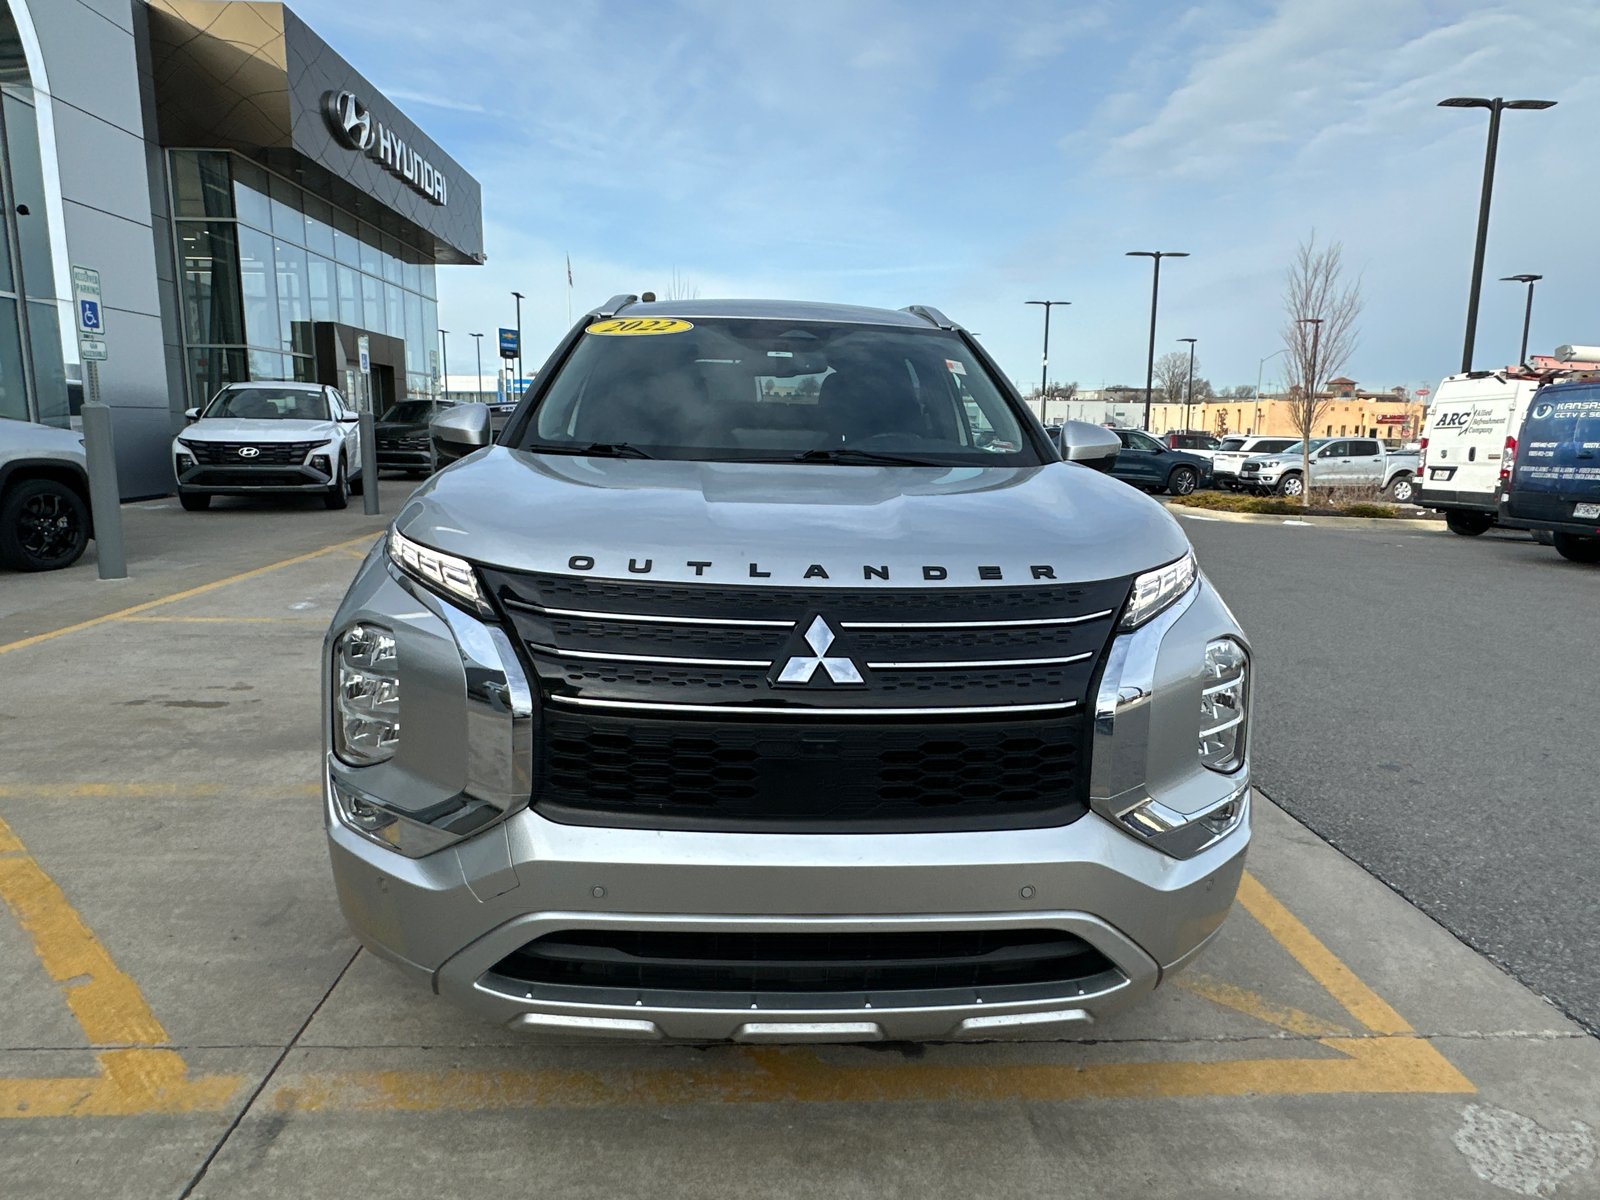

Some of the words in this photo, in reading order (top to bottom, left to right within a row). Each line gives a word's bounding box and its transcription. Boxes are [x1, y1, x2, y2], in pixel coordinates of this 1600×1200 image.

[377, 121, 447, 206] HYUNDAI
[601, 320, 677, 332] 2022
[1435, 412, 1471, 426] ARC
[1473, 417, 1506, 426] Refreshment
[568, 555, 1057, 580] OUTLANDER
